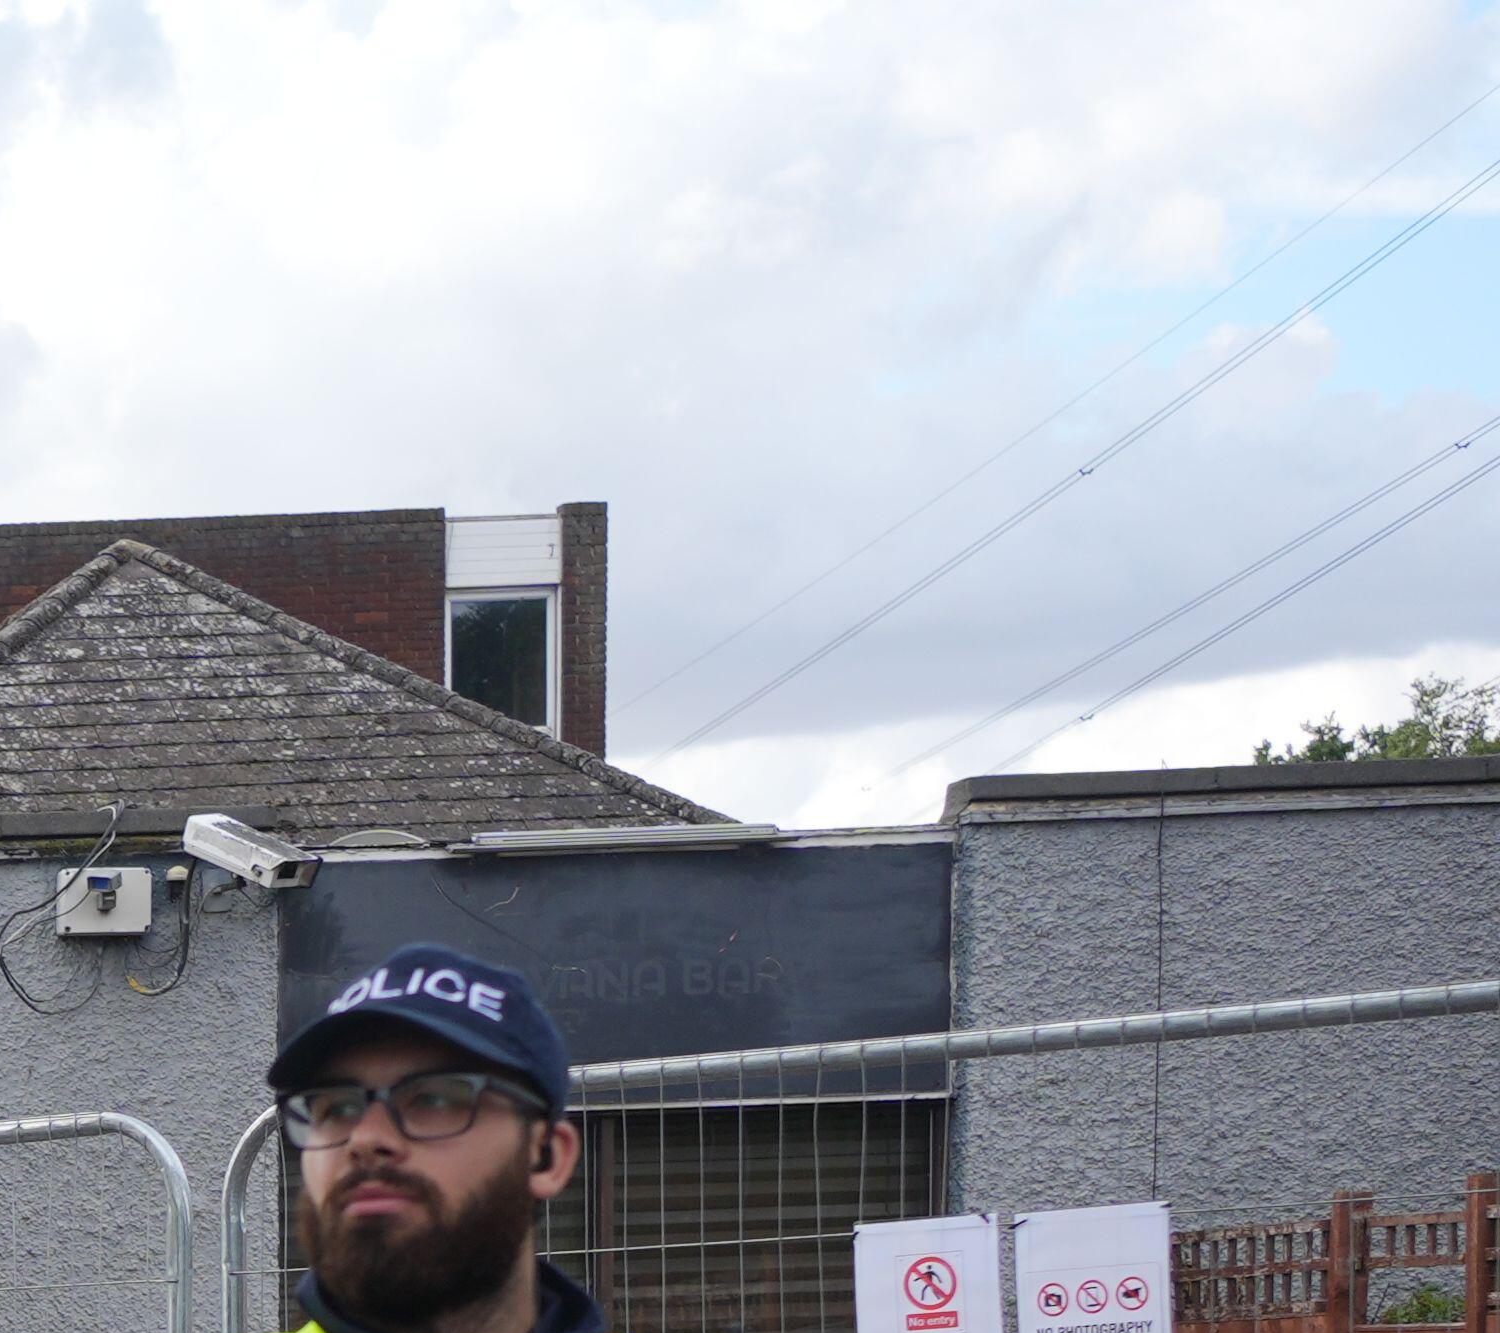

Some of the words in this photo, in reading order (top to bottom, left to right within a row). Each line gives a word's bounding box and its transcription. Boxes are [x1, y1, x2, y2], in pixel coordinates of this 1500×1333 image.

[328, 967, 506, 1022] OLICE
[909, 1317, 924, 1327] No
[926, 1315, 957, 1327] entry
